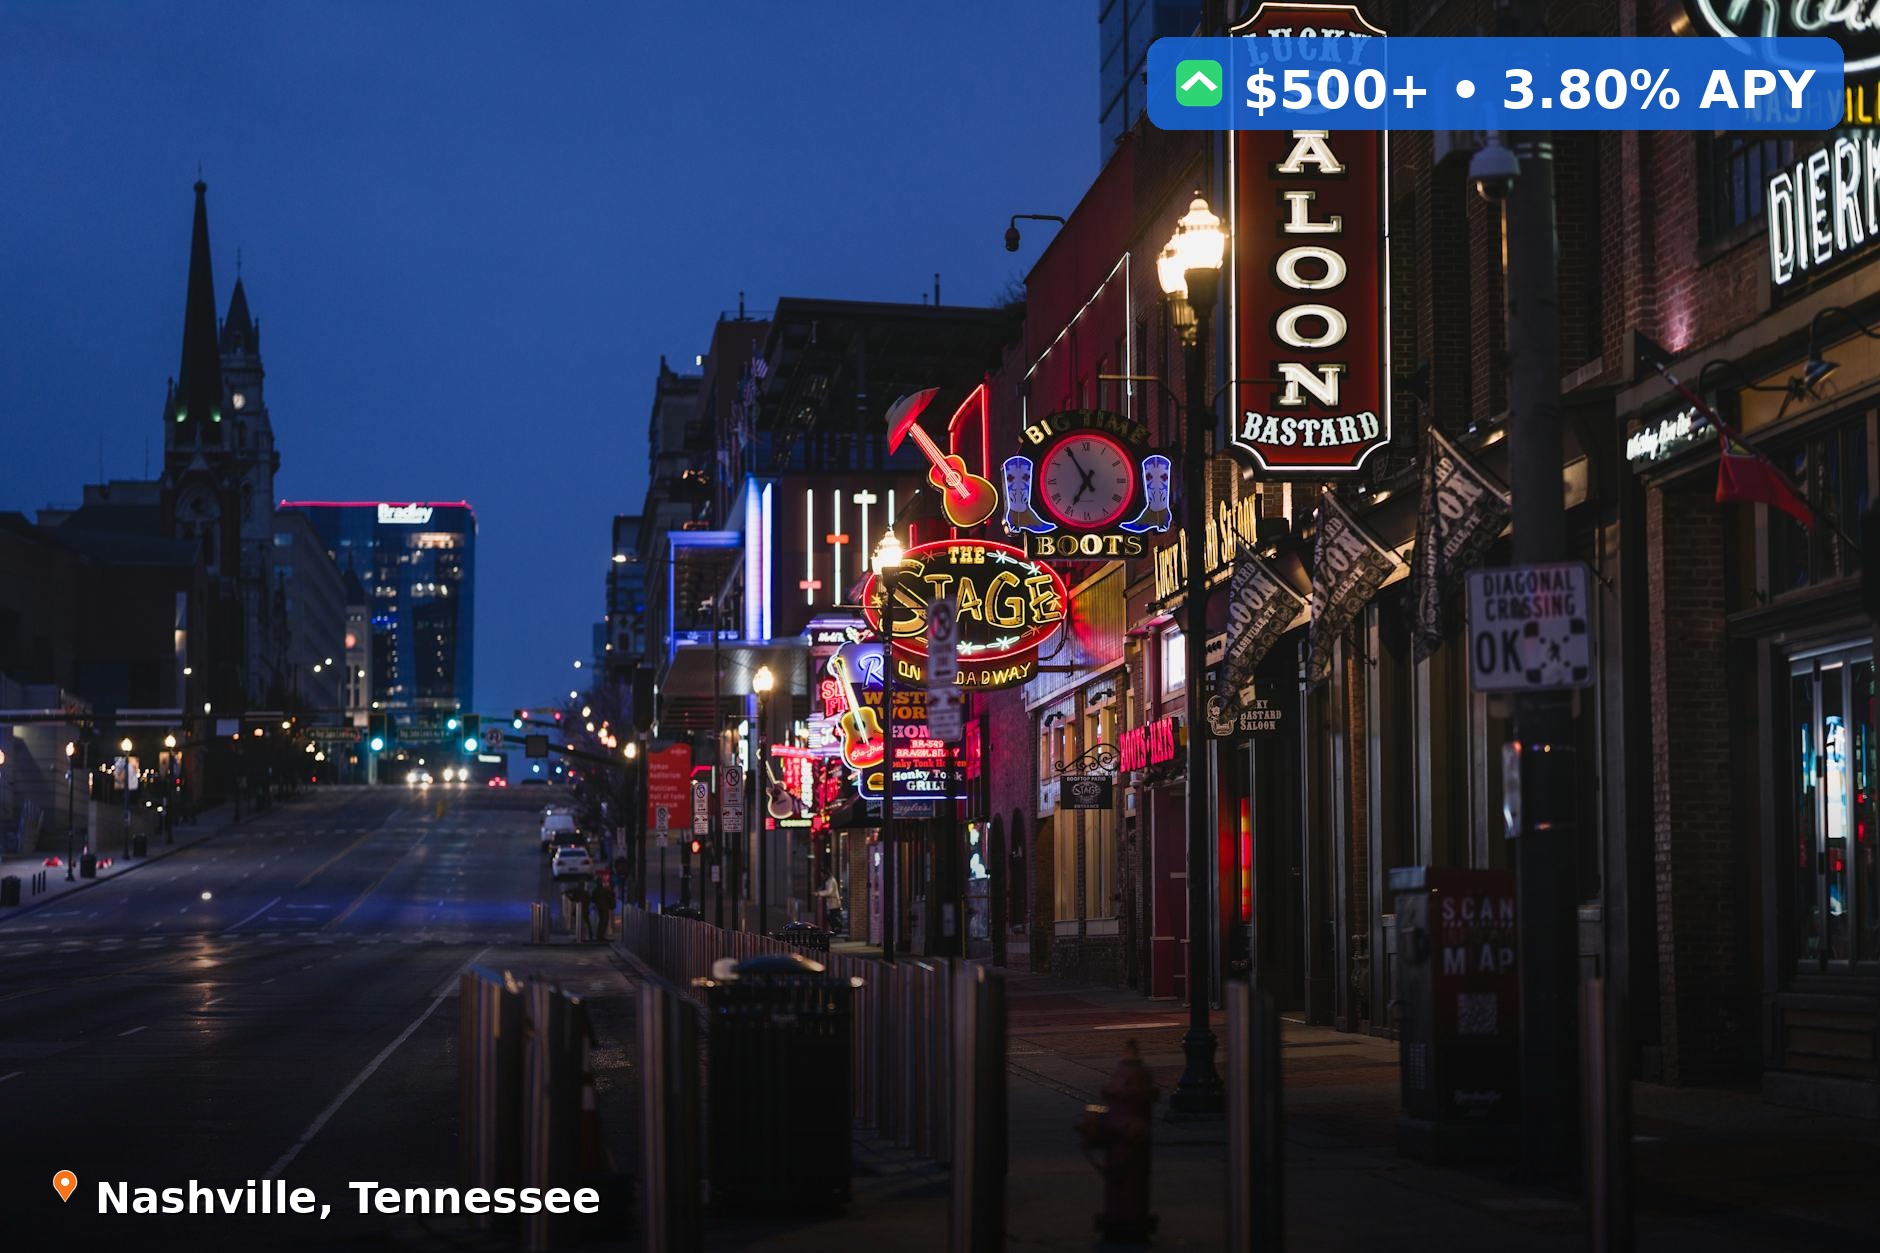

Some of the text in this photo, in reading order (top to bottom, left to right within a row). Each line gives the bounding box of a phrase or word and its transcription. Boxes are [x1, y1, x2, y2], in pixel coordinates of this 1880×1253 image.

[1024, 408, 1149, 445] BIG TIME
[1241, 412, 1379, 446] BASTARD
[948, 546, 985, 564] THE
[1034, 534, 1142, 556] BOOTS
[1483, 569, 1576, 597] DIAGONAL
[877, 558, 1063, 638] STAGE
[1476, 629, 1522, 675] OK
[899, 660, 921, 681] ON
[1239, 719, 1276, 731] SALOON
[1119, 716, 1175, 773] BOOTS HATS
[892, 769, 930, 781] Honky
[1441, 896, 1514, 920] SCAN
[1443, 943, 1514, 976] MAP
